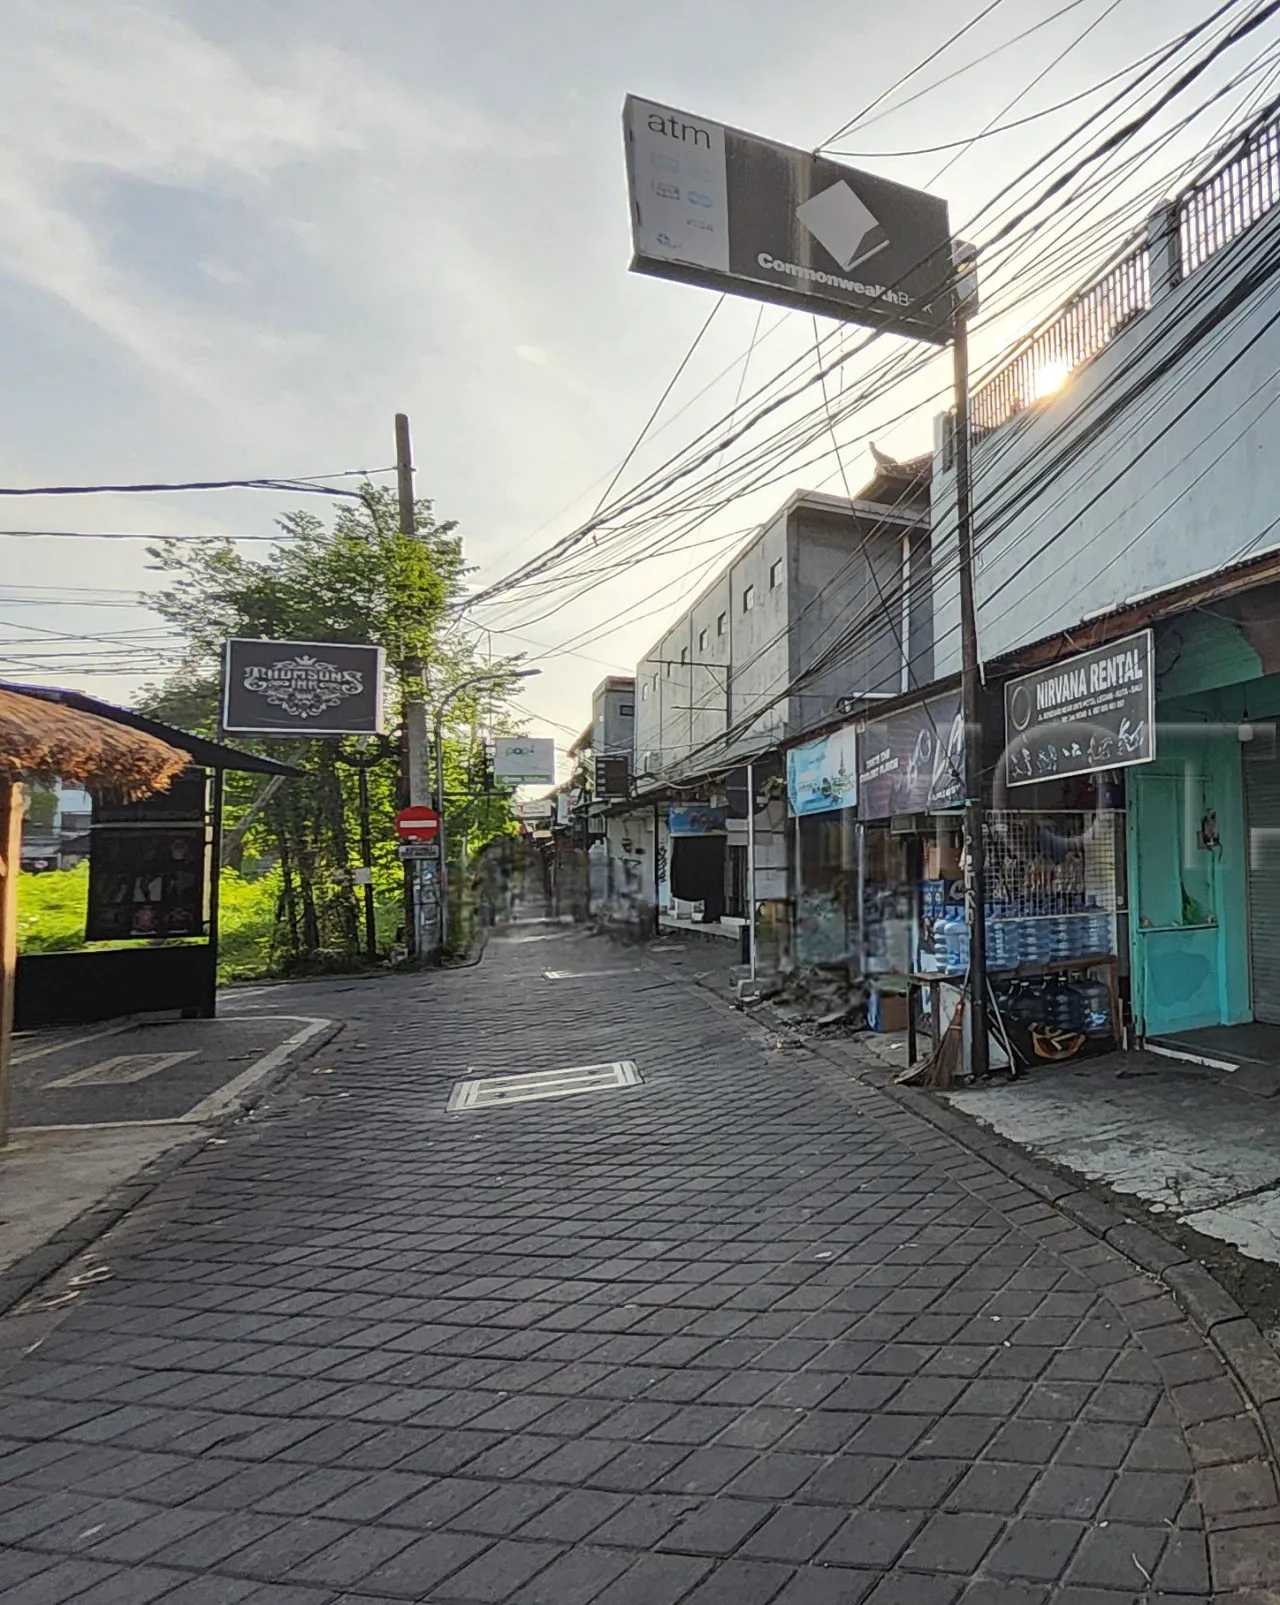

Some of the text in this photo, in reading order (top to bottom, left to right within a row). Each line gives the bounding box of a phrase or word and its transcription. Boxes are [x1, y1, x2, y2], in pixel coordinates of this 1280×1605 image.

[647, 113, 712, 150] atm
[1036, 648, 1143, 710] NIRVANA RENTAL
